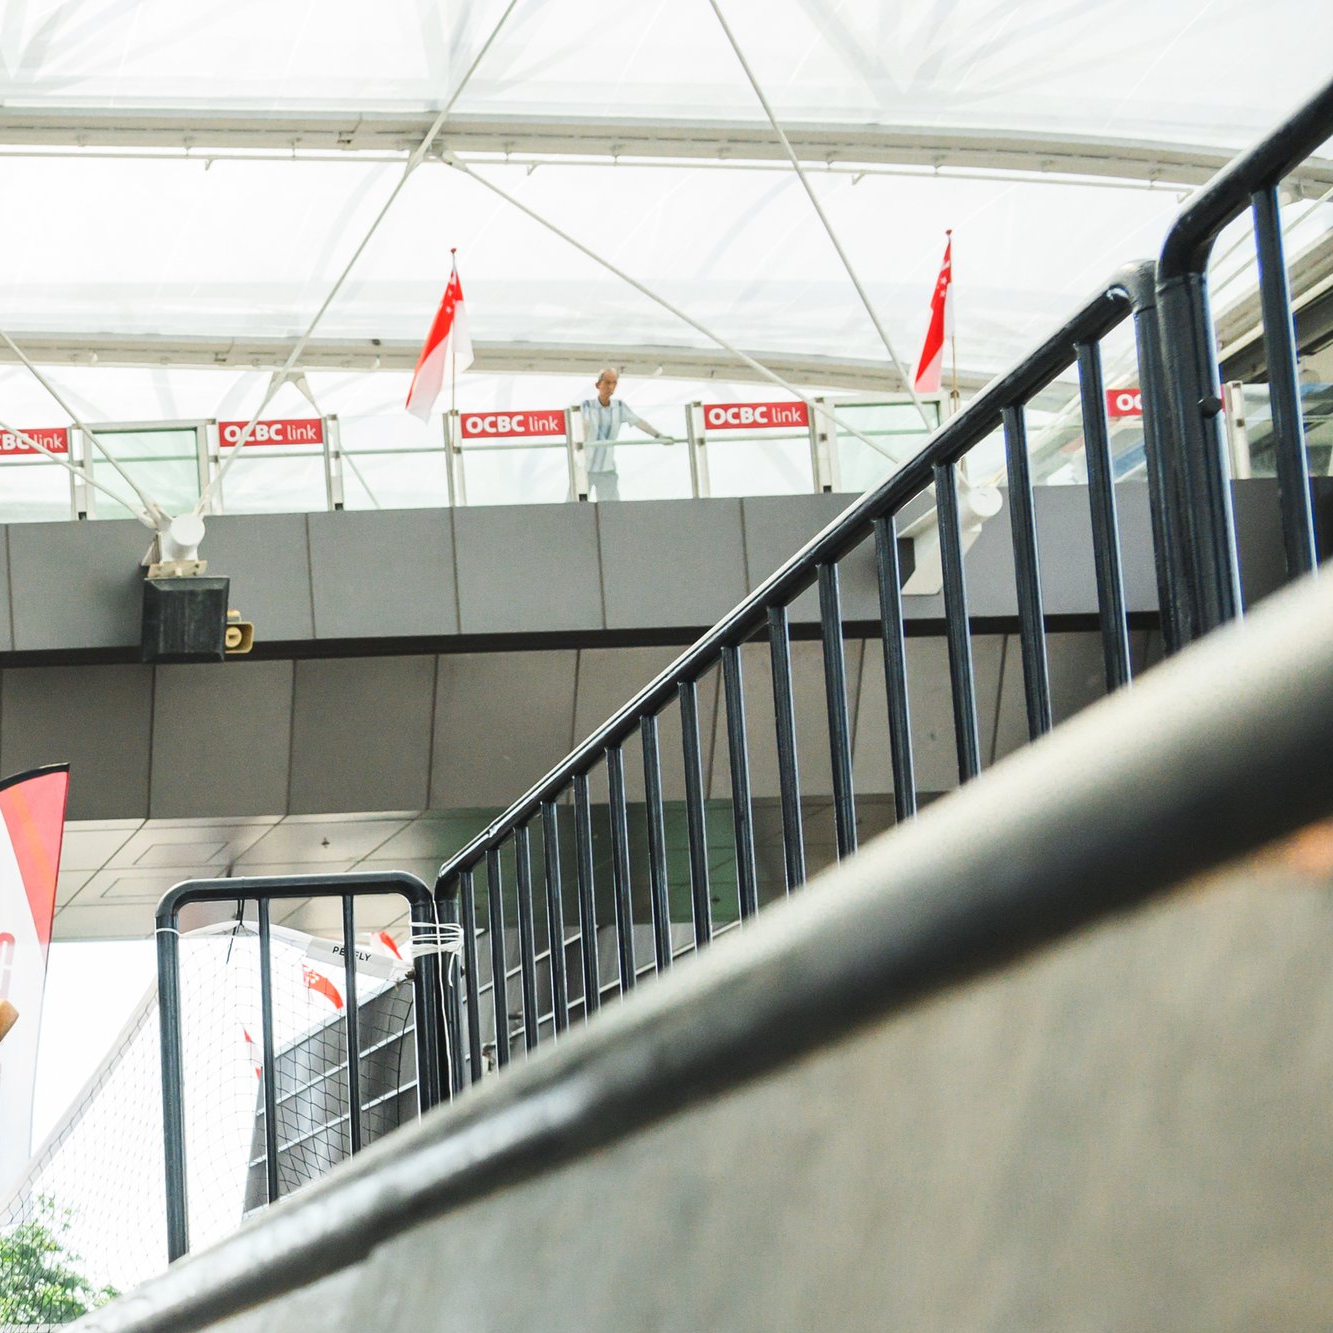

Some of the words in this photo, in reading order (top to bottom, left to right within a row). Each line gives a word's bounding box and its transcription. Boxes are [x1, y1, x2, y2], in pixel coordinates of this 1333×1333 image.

[465, 415, 526, 434] OCBC
[528, 415, 559, 432] link
[708, 406, 769, 426] OCBC
[771, 406, 802, 424] link
[286, 424, 317, 440] link
